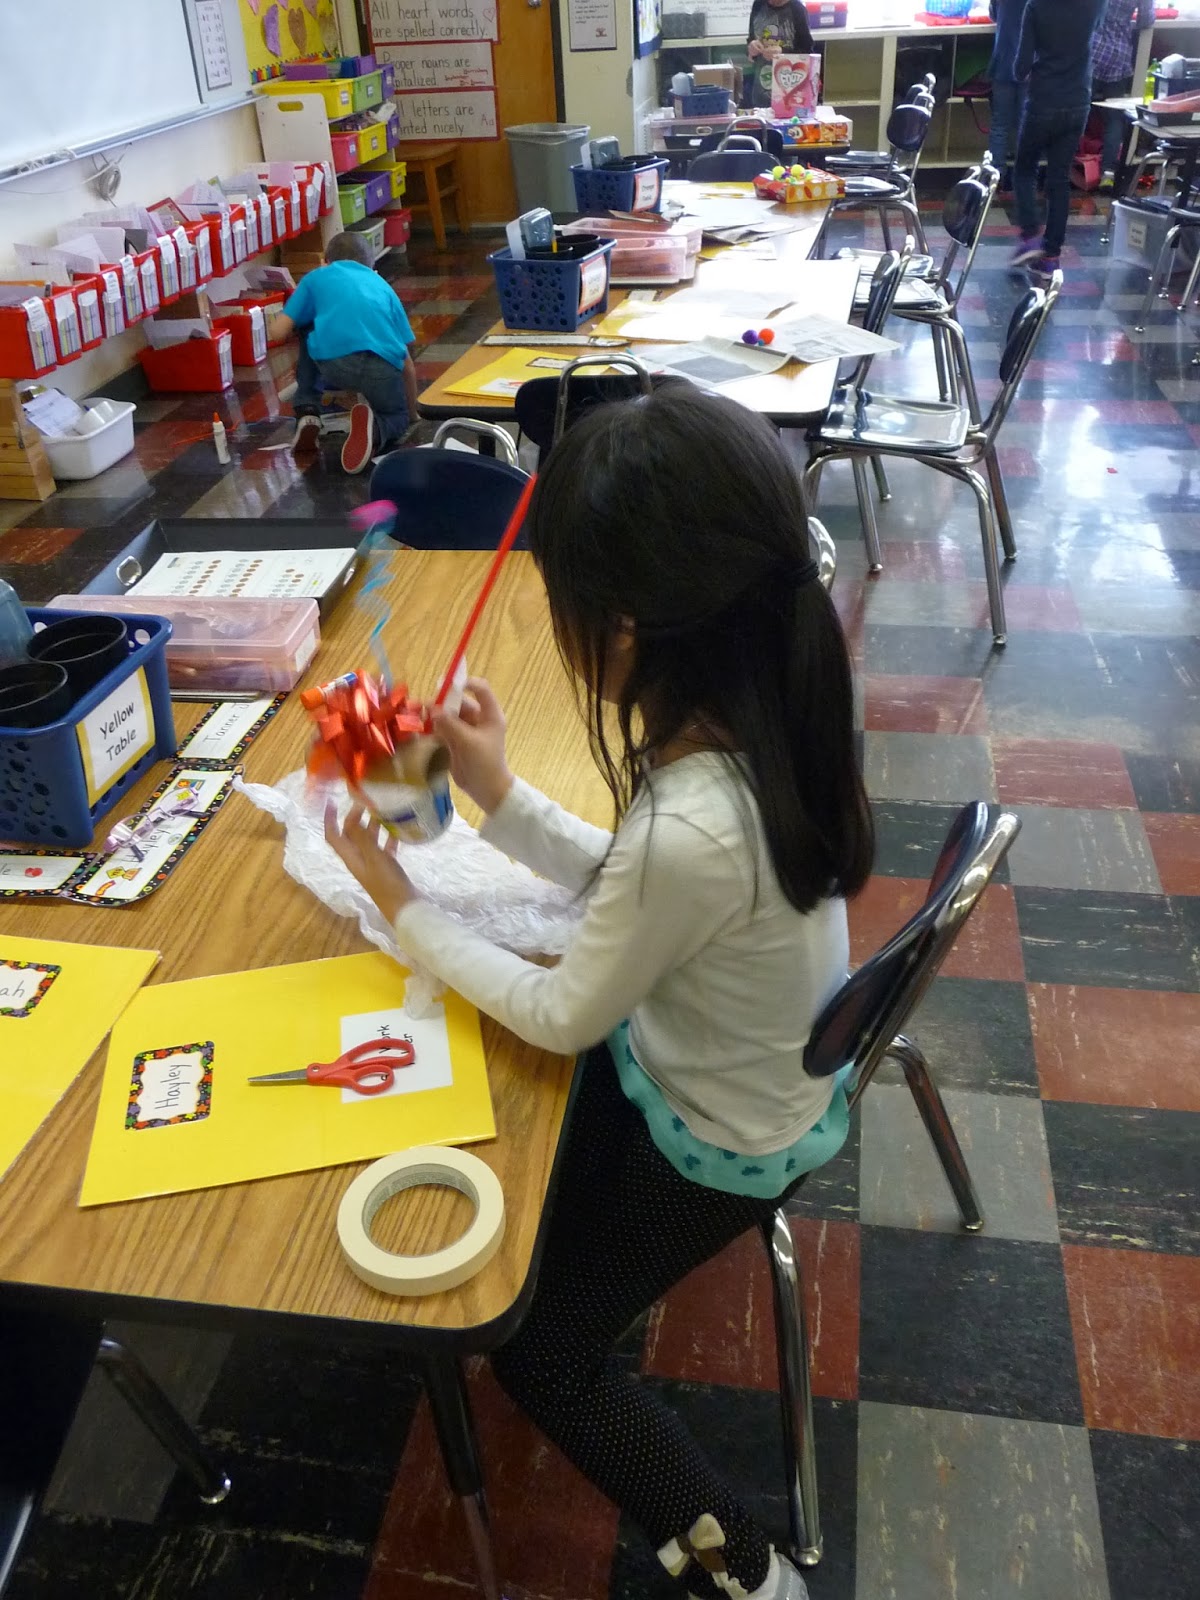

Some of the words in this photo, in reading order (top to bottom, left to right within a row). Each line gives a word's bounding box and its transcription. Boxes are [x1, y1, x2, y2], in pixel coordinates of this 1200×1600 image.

[371, 0, 390, 20] All
[398, 0, 429, 20] heart
[438, 0, 475, 19] words
[373, 27, 392, 38] are
[398, 20, 436, 41] spelled
[421, 58, 451, 69] nouns
[454, 57, 472, 69] are
[393, 69, 437, 88] pitalized
[412, 99, 450, 117] letters
[455, 106, 475, 116] are
[433, 117, 465, 136] nicely
[100, 702, 134, 740] Yellow
[202, 714, 240, 742] Tanner
[106, 729, 137, 761] Table
[155, 1063, 192, 1110] Hayley
